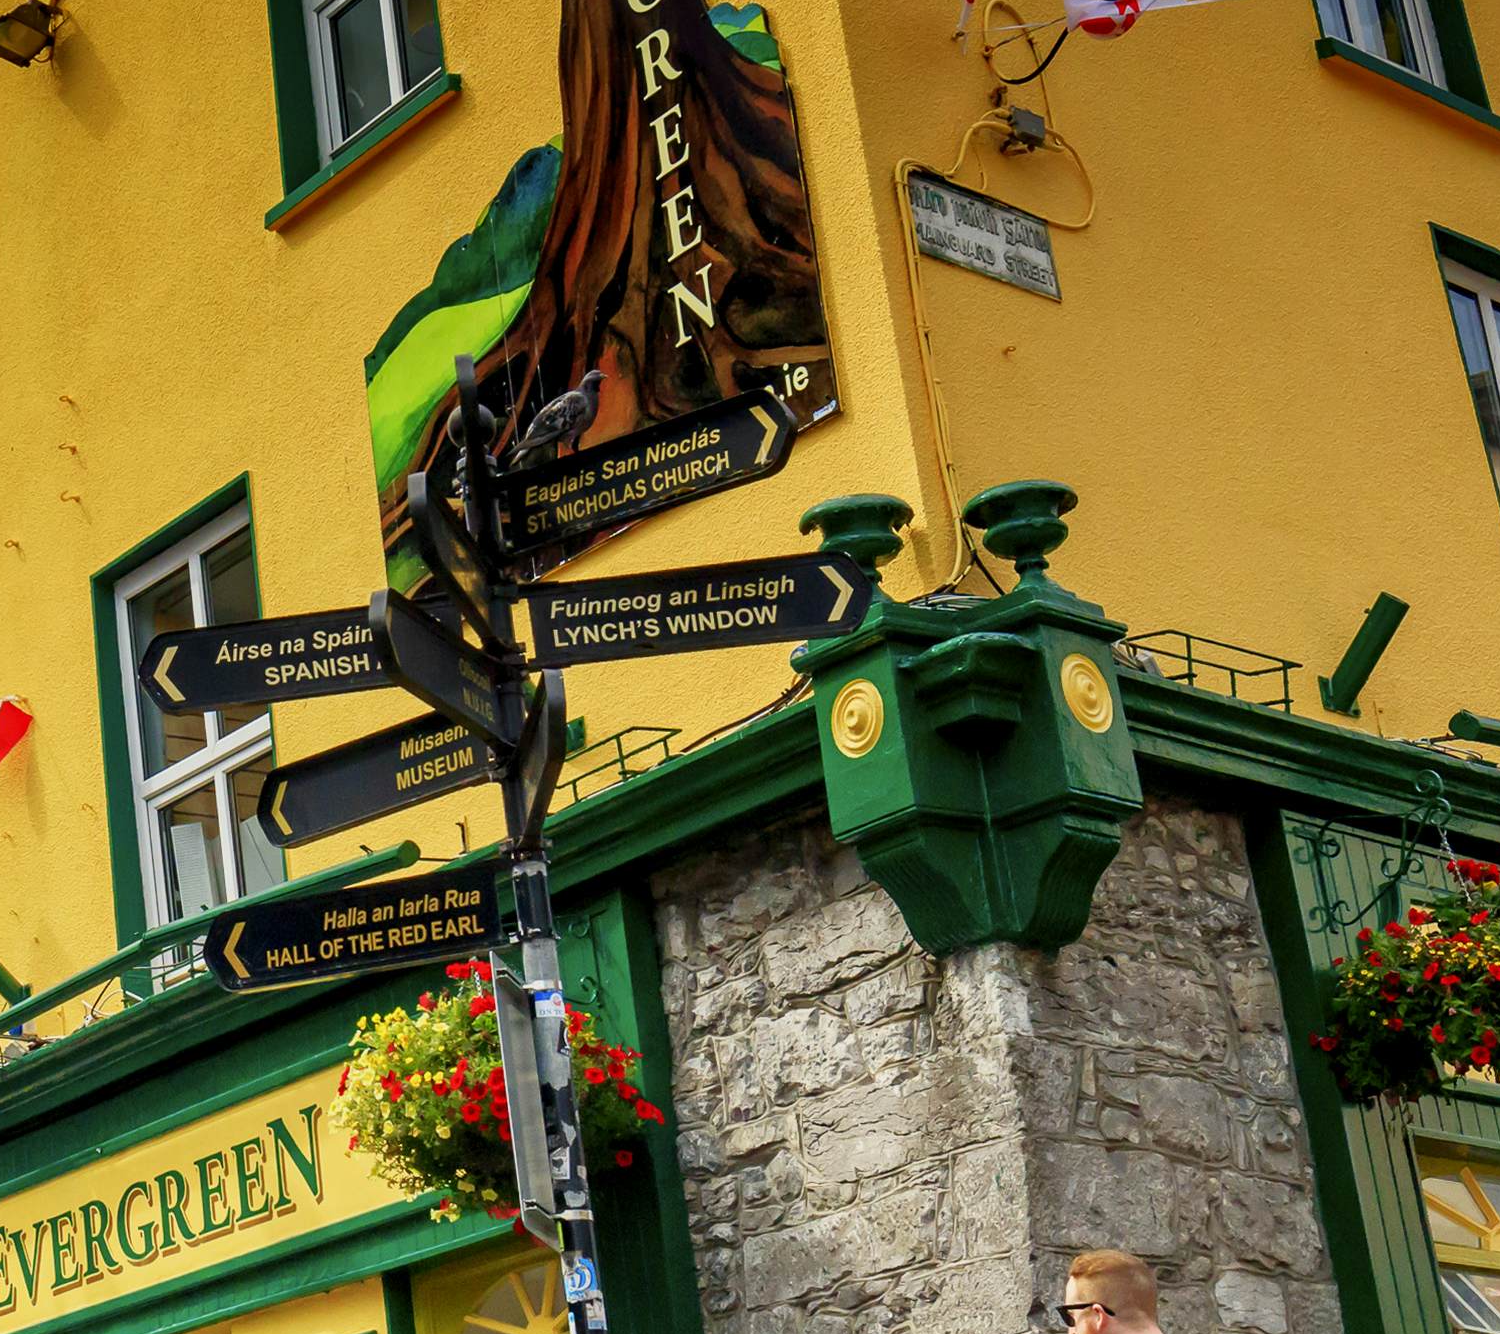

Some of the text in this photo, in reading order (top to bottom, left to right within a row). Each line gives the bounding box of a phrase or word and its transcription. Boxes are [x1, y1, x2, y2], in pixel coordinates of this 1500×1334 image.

[1004, 249, 1056, 287] STREET
[525, 427, 721, 509] Eaglais San Nioclás
[527, 450, 730, 534] ST. NICHOLAS CHURCH
[551, 575, 795, 620] Fuinneog an Linsigh
[215, 623, 373, 665] Áirse na Spáin
[552, 604, 778, 648] LYNCH'S WINDOW
[265, 652, 369, 686] SPANISH
[396, 746, 474, 791] MUSEUM
[323, 888, 481, 932] Halla an Iarla Rua
[266, 915, 484, 970] HALL OF THE RED EARL
